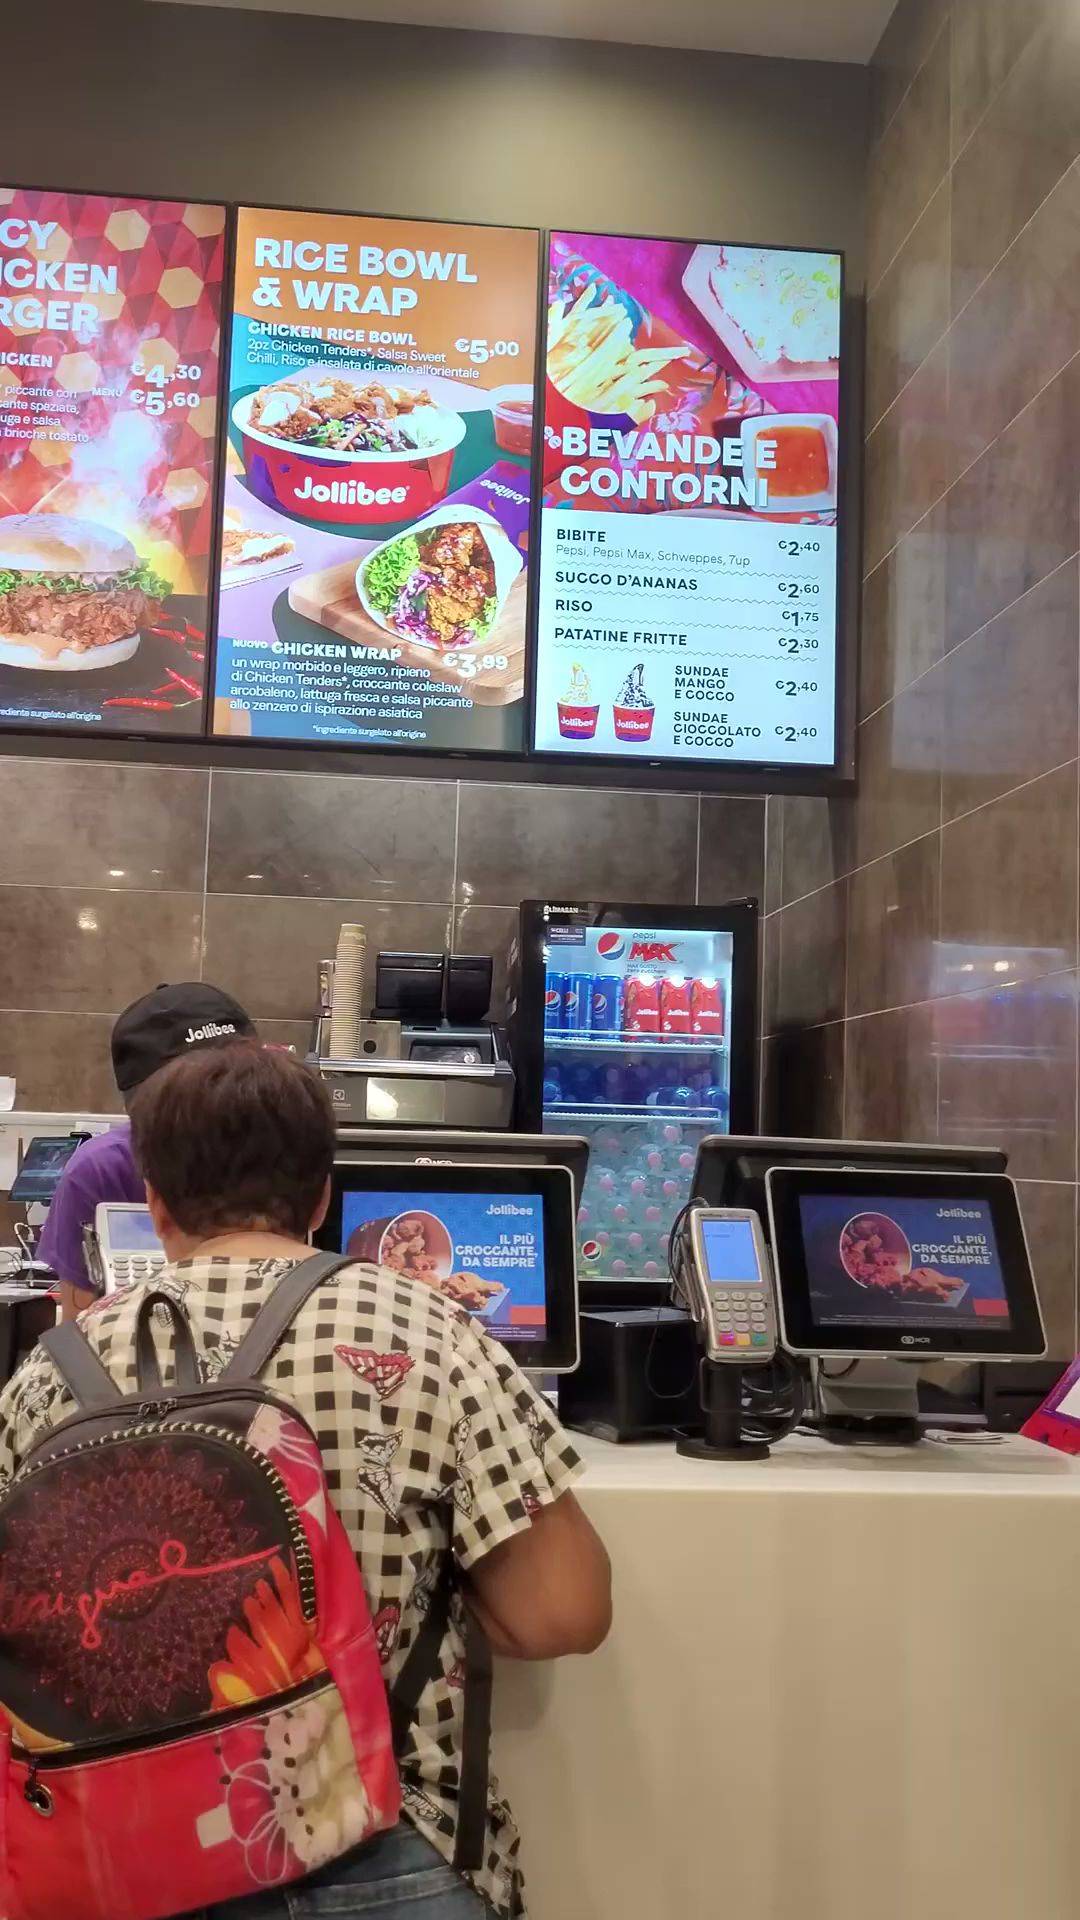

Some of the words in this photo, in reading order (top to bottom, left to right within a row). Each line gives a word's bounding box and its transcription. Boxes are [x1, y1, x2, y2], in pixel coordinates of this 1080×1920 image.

[0, 218, 58, 250] CY
[254, 238, 348, 273] RICE
[359, 245, 478, 283] BOWL
[0, 257, 117, 294] CKEN
[252, 277, 283, 308] &
[292, 279, 418, 317] WRAP
[248, 321, 322, 339] CHICKEN
[327, 327, 365, 342] RICE
[369, 331, 417, 346] BOWL
[247, 338, 269, 353] 2pz
[271, 340, 319, 354] Chicken
[377, 347, 407, 360] Salsa
[410, 349, 446, 363] Sweet
[454, 338, 520, 364] €5,00
[246, 351, 279, 366] Chilli,
[281, 352, 305, 366] Riso
[307, 358, 315, 367] e
[317, 356, 361, 370] insalata
[363, 359, 375, 371] di
[376, 360, 414, 374] cavolo
[416, 364, 479, 379] all'orientale
[130, 363, 201, 388] €4,30
[5, 385, 54, 397] piccante
[56, 389, 77, 398] con
[30, 402, 80, 415] speziata,
[130, 389, 200, 415] €5,60
[23, 417, 30, 425] e
[32, 416, 61, 425] salsa
[4, 427, 46, 439] brioche
[49, 431, 88, 443] tostato
[562, 427, 745, 467] BEVANDE
[755, 440, 778, 469] E
[293, 476, 407, 505] Jollibee
[560, 465, 768, 507] CONTORNI
[556, 529, 606, 543] BIBITE
[556, 544, 590, 558] Pepsi,
[593, 547, 624, 560] Pepsi
[627, 549, 655, 563] Max,
[657, 551, 726, 566] Schweppes,
[729, 555, 750, 567] 7up
[555, 571, 612, 585] SUCCO
[617, 574, 698, 591] D'ANANAS
[555, 600, 593, 612] RISO
[554, 627, 628, 643] PATATINE
[633, 631, 687, 646] FRITTE
[232, 639, 268, 649] NUOVO
[271, 641, 348, 659] CHICKEN
[351, 645, 402, 661] WRAP
[231, 658, 248, 669] un
[250, 660, 280, 672] wrap
[282, 658, 332, 673] morbido
[333, 664, 341, 673] e
[343, 662, 388, 678] leggero,
[390, 665, 430, 681] ripieno
[442, 653, 508, 678] €3,99
[675, 665, 729, 678] SUNDAE
[231, 670, 243, 682] di
[244, 670, 295, 685] Chicken
[352, 677, 410, 692] croccante
[412, 679, 462, 693] coleslaw
[675, 677, 725, 690] MANGO
[230, 684, 298, 700] arcobaleno,
[300, 688, 341, 704] lattuga
[343, 690, 379, 704] fresca
[381, 694, 389, 704] e
[391, 691, 421, 705] salsa
[422, 694, 473, 709] piccante
[675, 690, 681, 700] E
[685, 690, 735, 702] COCCO
[230, 698, 250, 710] allo
[252, 701, 298, 713] zenzero
[300, 702, 312, 713] di
[314, 703, 376, 719] ispirazione
[378, 706, 423, 720] asiatica
[674, 712, 728, 724] SUNDAE
[673, 723, 761, 738] CIOCCOLATO
[673, 735, 680, 745] E
[685, 736, 734, 748] COCCO
[628, 942, 681, 962] MAX
[185, 1022, 236, 1043] Jollibee
[485, 1203, 533, 1216] Jollibee
[936, 1207, 982, 1219] Jollibee
[500, 1234, 511, 1245] IL
[513, 1232, 534, 1246] PIÙ
[953, 1235, 965, 1245] IL
[967, 1233, 987, 1245] PIÙ
[455, 1245, 538, 1258] CROCCANTE,
[911, 1243, 992, 1256] CROCCANTE,
[920, 1253, 938, 1264] DA
[940, 1254, 990, 1265] SEMPRE
[462, 1257, 482, 1268] DA
[483, 1257, 535, 1268] SEMPRE
